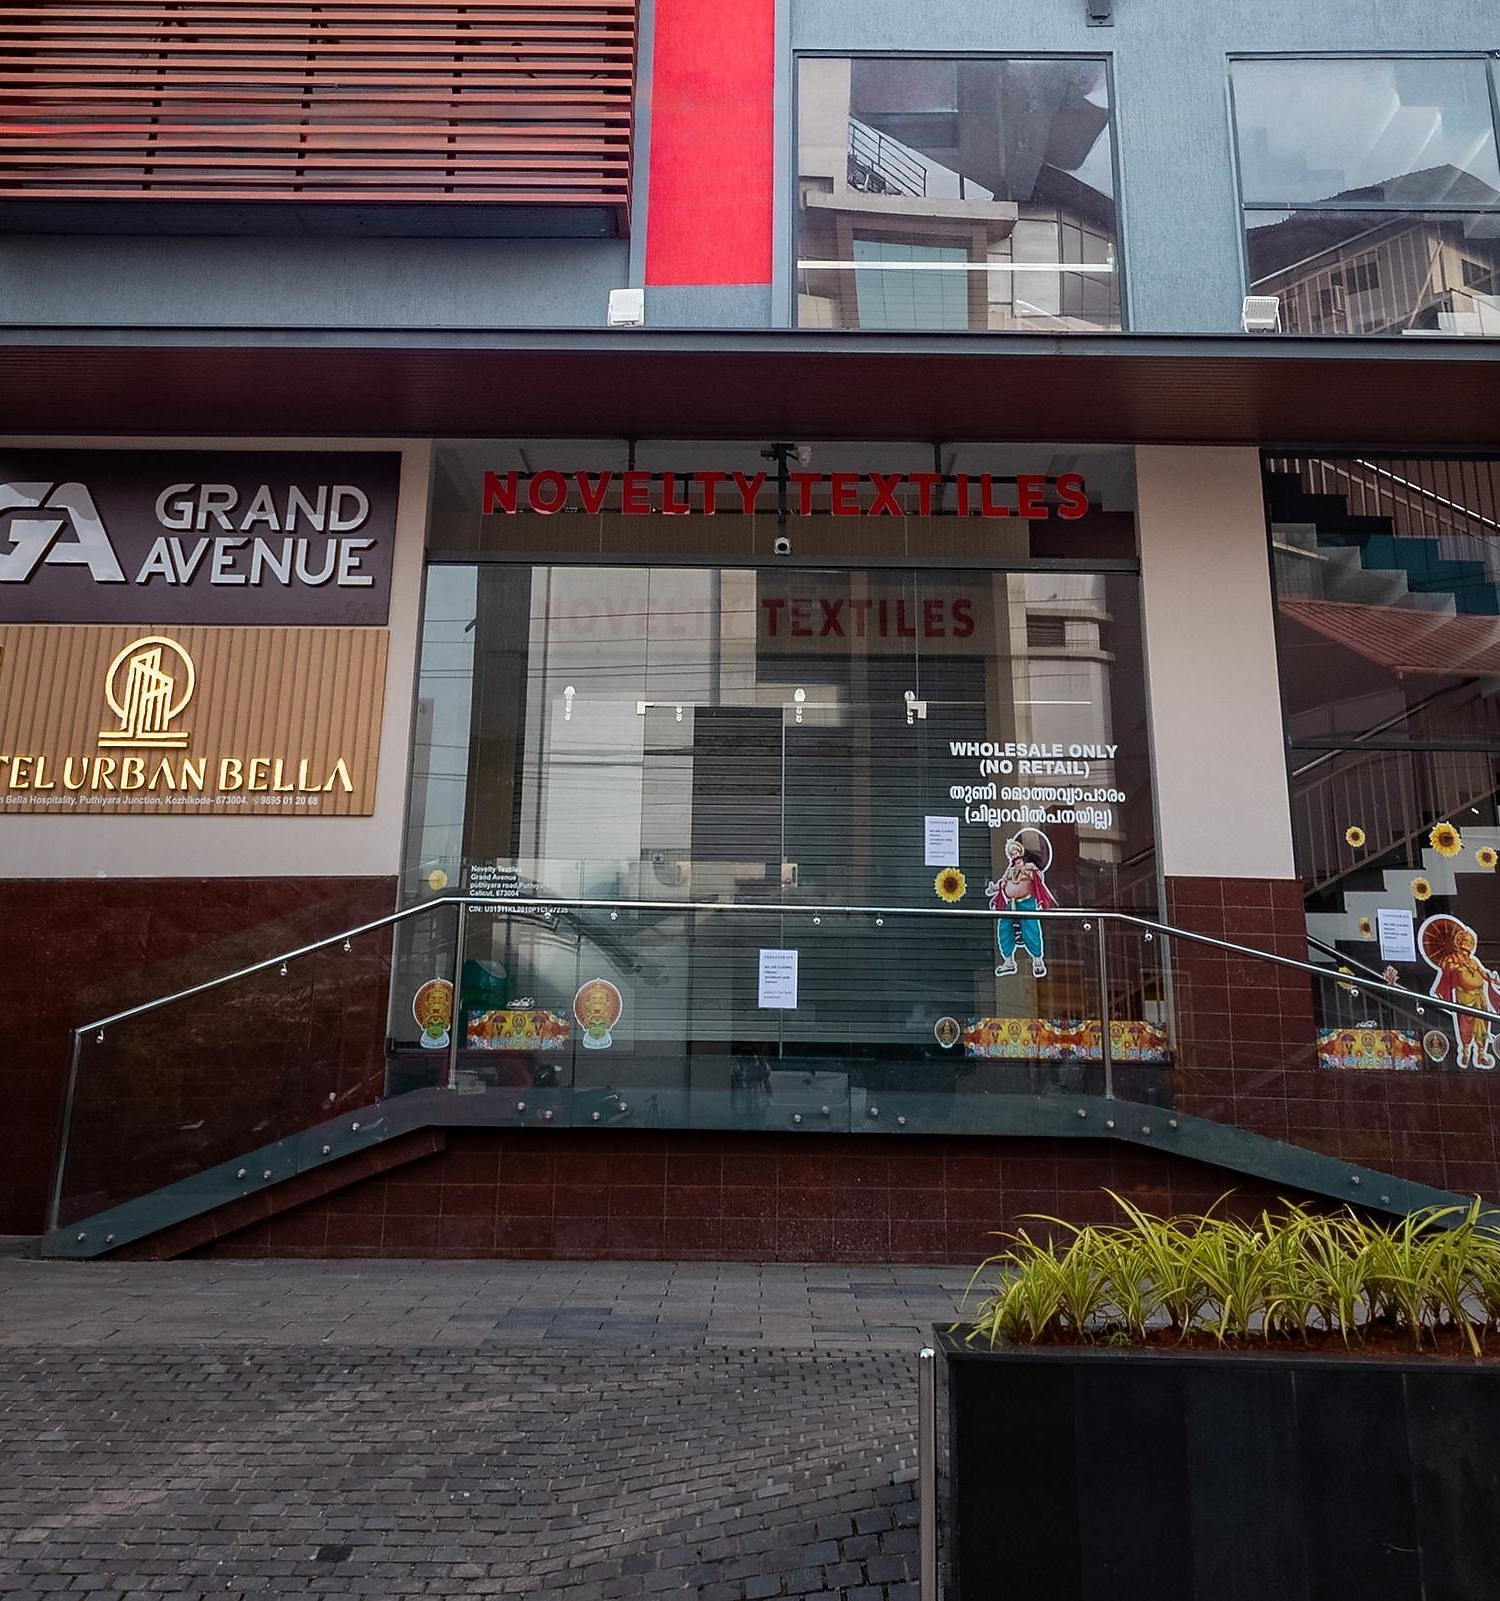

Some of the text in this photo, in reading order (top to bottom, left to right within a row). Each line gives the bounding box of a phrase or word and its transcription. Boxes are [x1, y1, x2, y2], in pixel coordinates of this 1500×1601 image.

[155, 483, 371, 533] GRAND
[481, 470, 1090, 520] NOVELTY TEXTILES
[135, 536, 378, 588] AVENUE
[761, 599, 975, 638] TEXTILES
[949, 741, 1118, 759] WHOLESALE ONLY
[63, 756, 208, 792] URBAN
[218, 757, 354, 793] BELLA
[979, 758, 1091, 778] (NO RETAIL)
[5, 794, 28, 805] Bella
[949, 782, 997, 804] തുണി
[470, 873, 491, 881] Grand
